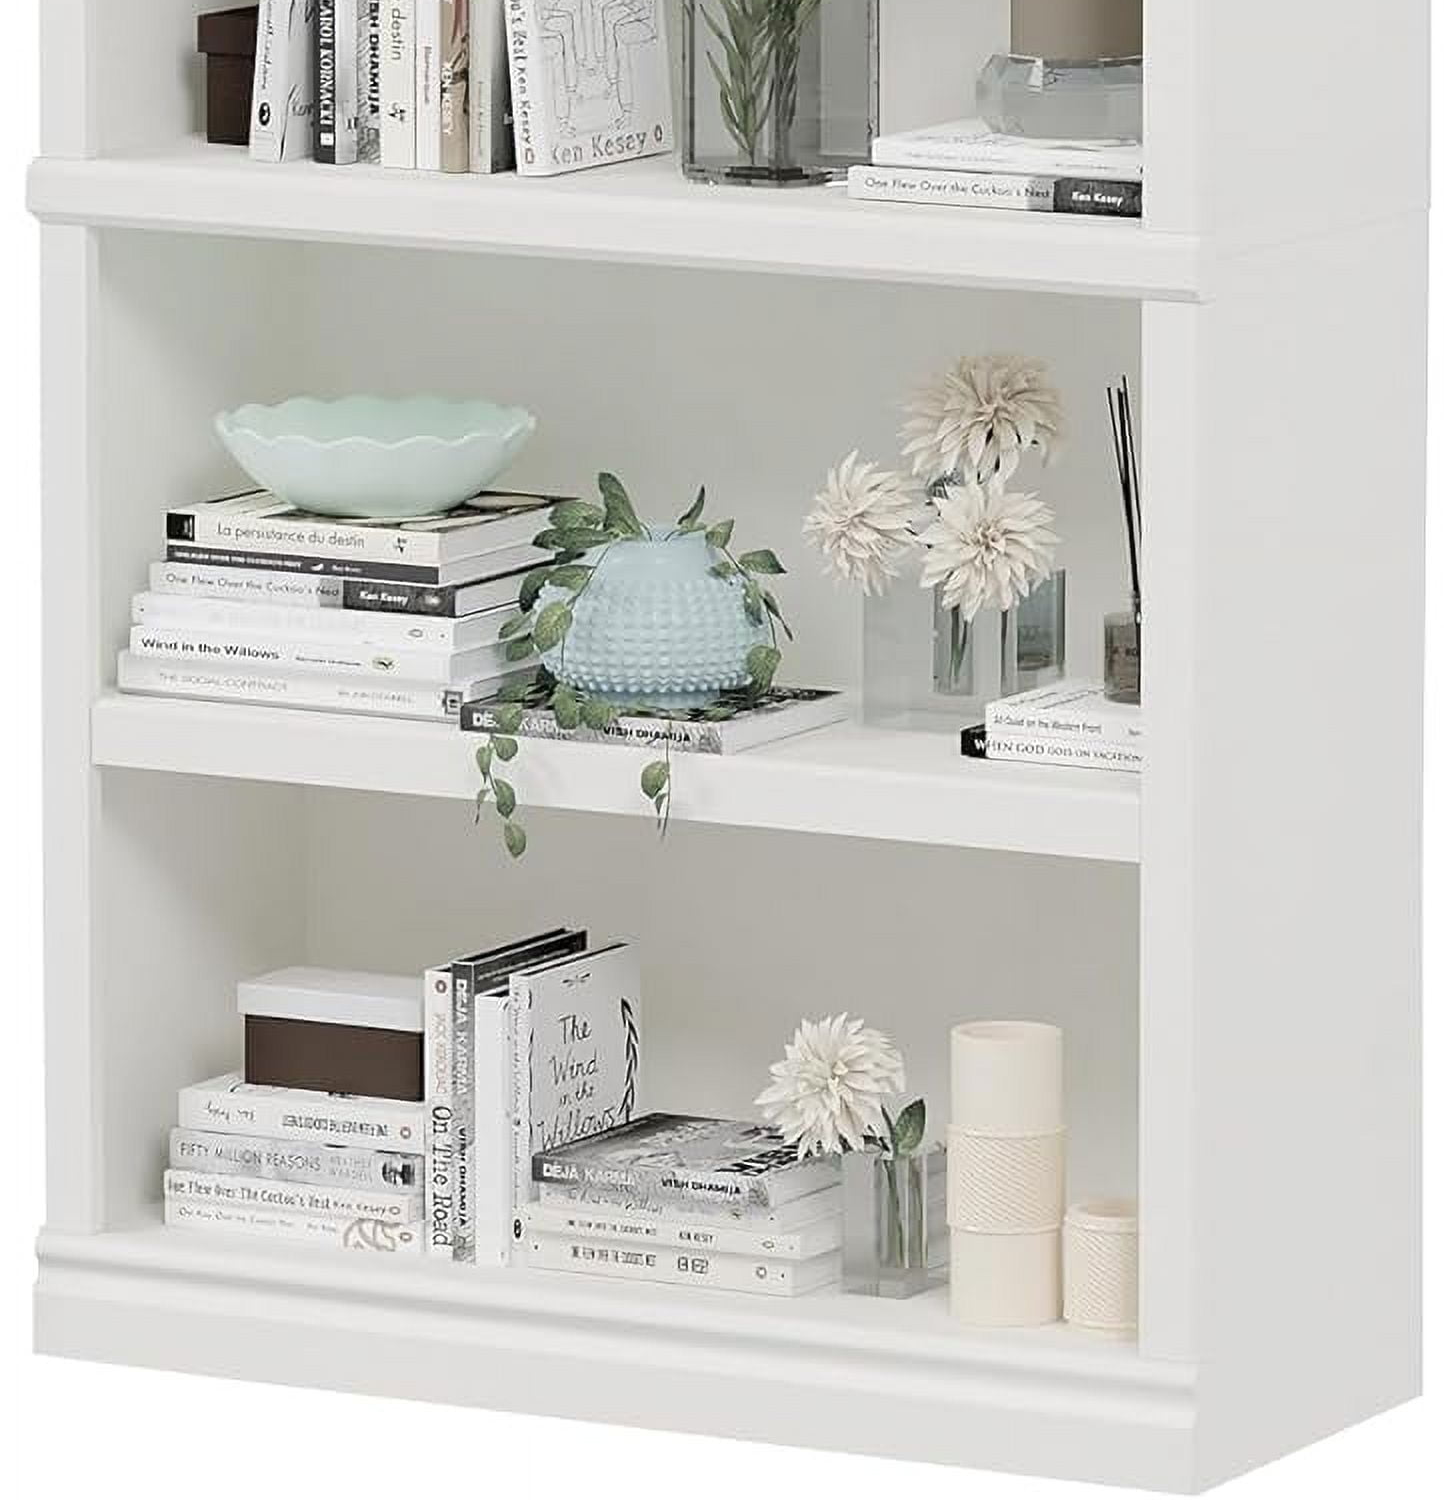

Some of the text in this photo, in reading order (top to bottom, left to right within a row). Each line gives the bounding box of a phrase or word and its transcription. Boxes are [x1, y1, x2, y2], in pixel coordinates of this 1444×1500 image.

[391, 7, 406, 61] destin
[319, 47, 334, 126] KORNACKI
[368, 31, 381, 117] DHAMIJA
[217, 522, 231, 537] La
[308, 530, 325, 545] du
[328, 531, 365, 549] destin
[141, 636, 280, 660] Wind in the Willows
[1015, 742, 1046, 755] GOD
[558, 1014, 593, 1045] The
[549, 1046, 598, 1086] Wind
[432, 1105, 453, 1134] On
[180, 1141, 208, 1157] FIFTY
[432, 1142, 453, 1186] The
[661, 1177, 690, 1190] VISH
[432, 1192, 453, 1247] Road
